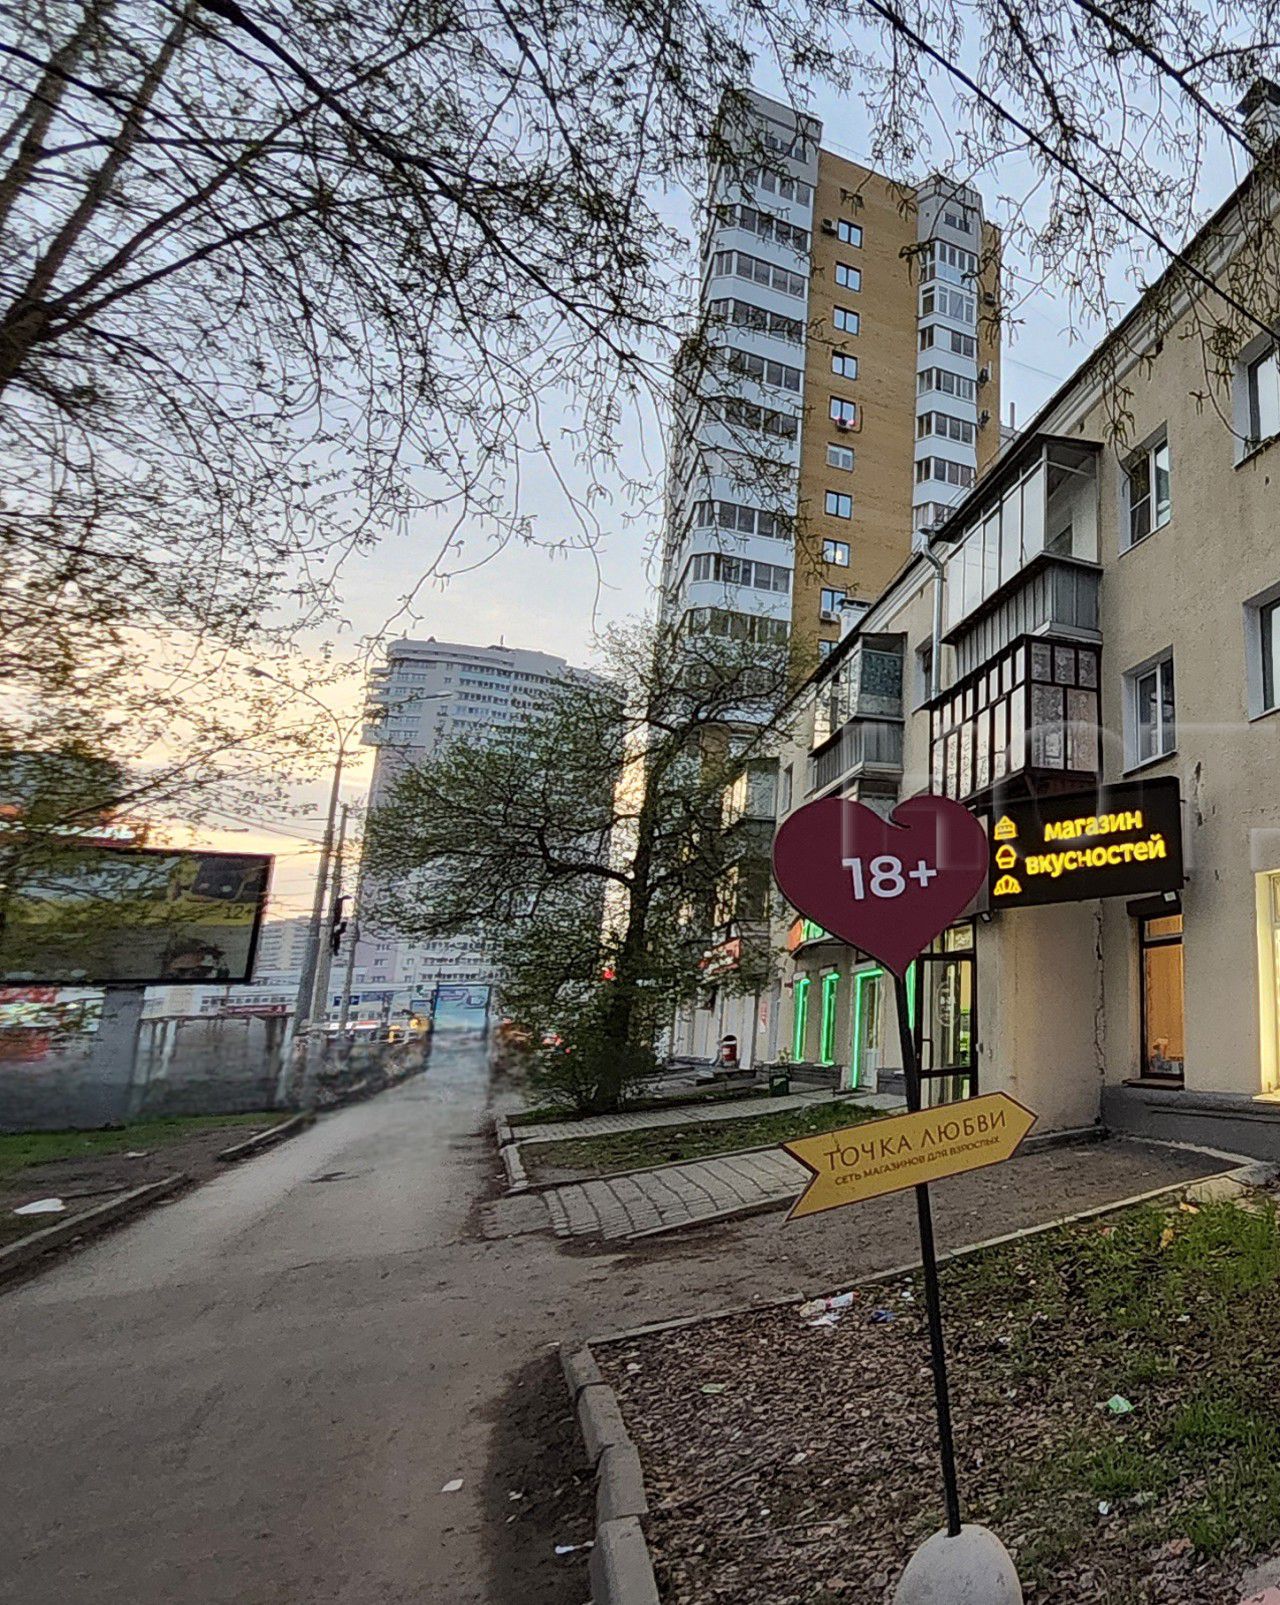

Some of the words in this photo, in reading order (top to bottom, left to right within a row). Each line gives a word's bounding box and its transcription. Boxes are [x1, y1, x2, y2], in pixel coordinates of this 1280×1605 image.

[1044, 810, 1143, 842] магазин
[841, 855, 938, 901] 18+
[1024, 833, 1167, 878] вкусностей
[823, 1134, 912, 1171] ТОЧКА
[920, 1110, 1007, 1148] ЛЮБВИ
[834, 1171, 862, 1187] СЕТЬ
[863, 1155, 926, 1179] МАГАЗИНОВ
[927, 1148, 949, 1164] ДЛЯ
